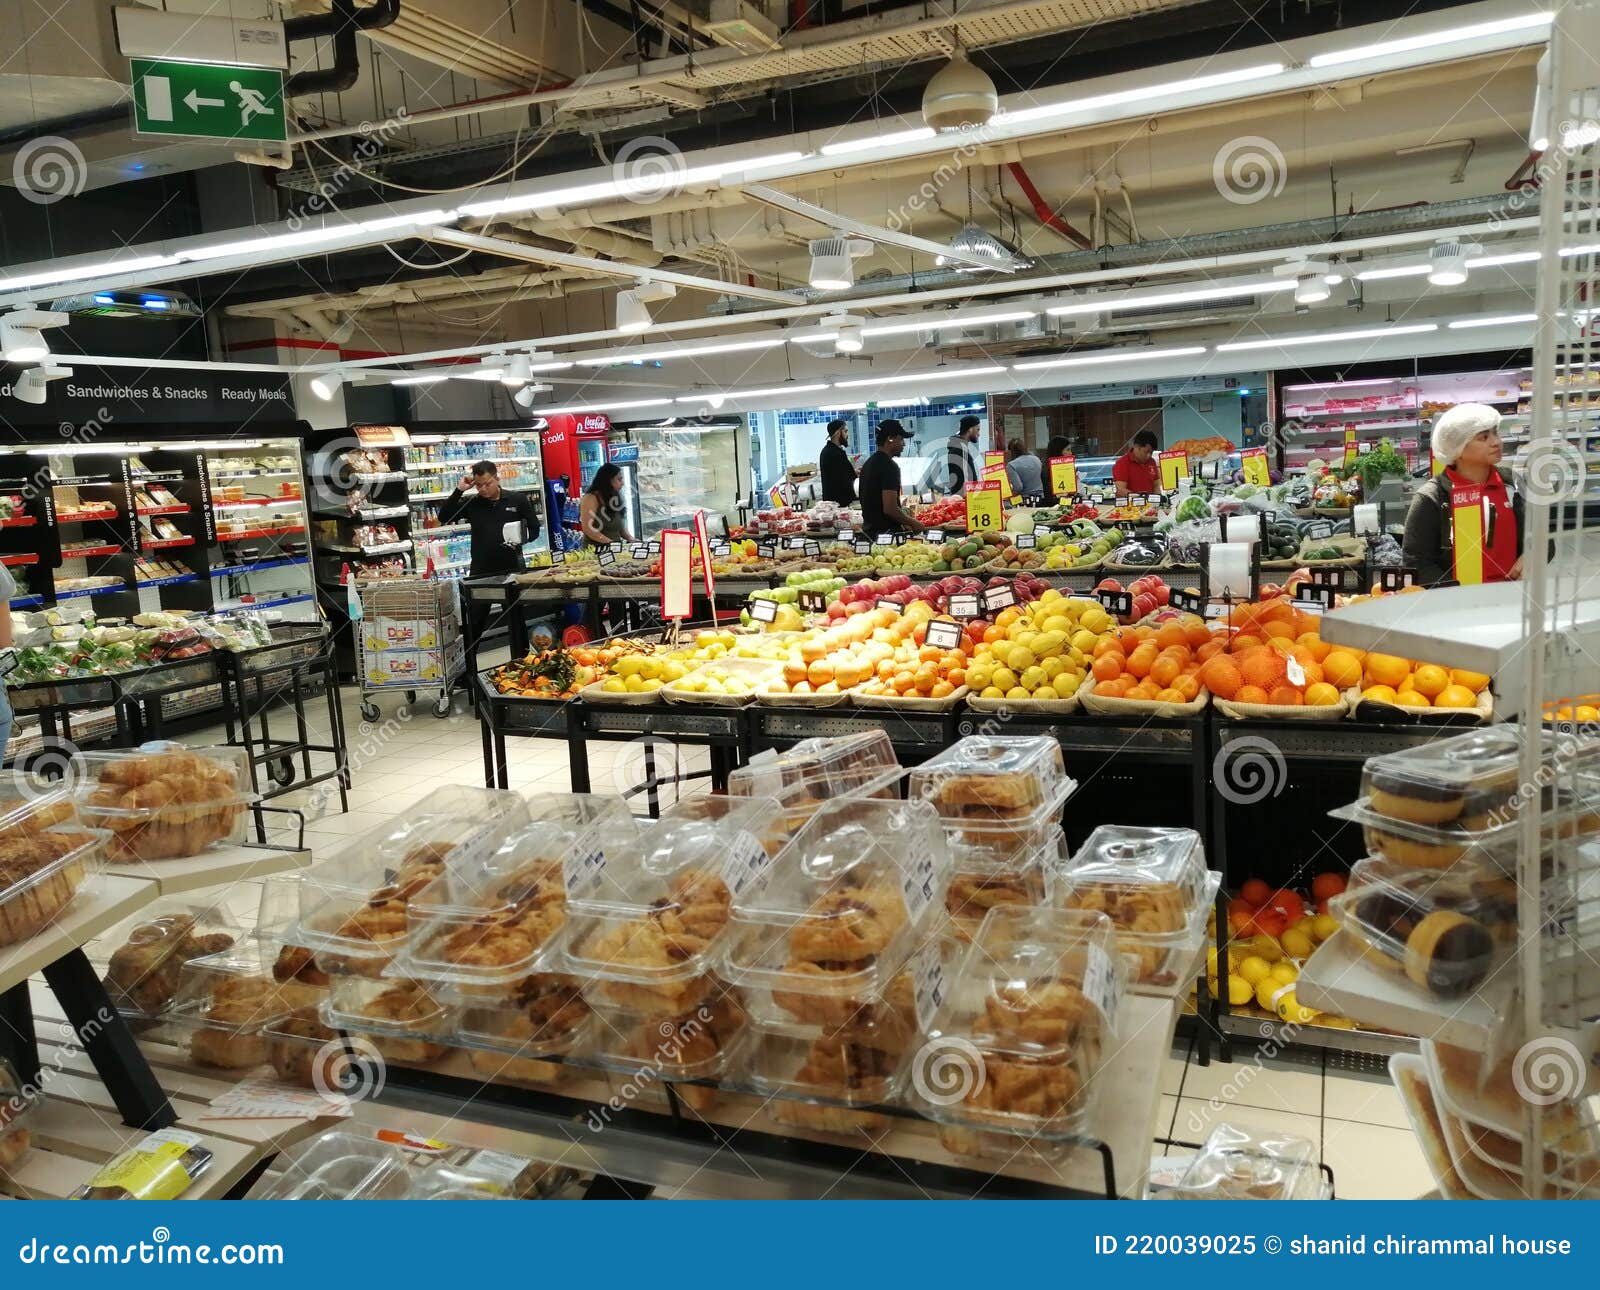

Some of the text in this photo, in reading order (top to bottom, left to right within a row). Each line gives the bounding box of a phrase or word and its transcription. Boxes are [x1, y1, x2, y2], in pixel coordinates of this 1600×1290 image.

[66, 384, 208, 399] Sandwiches & Snacks
[221, 388, 287, 402] Ready Meals
[548, 432, 565, 443] cold
[196, 454, 208, 502] Sandwiches
[1252, 475, 1259, 485] 5
[1058, 480, 1065, 490] 4
[972, 514, 991, 528] 18
[387, 626, 414, 638] Dole
